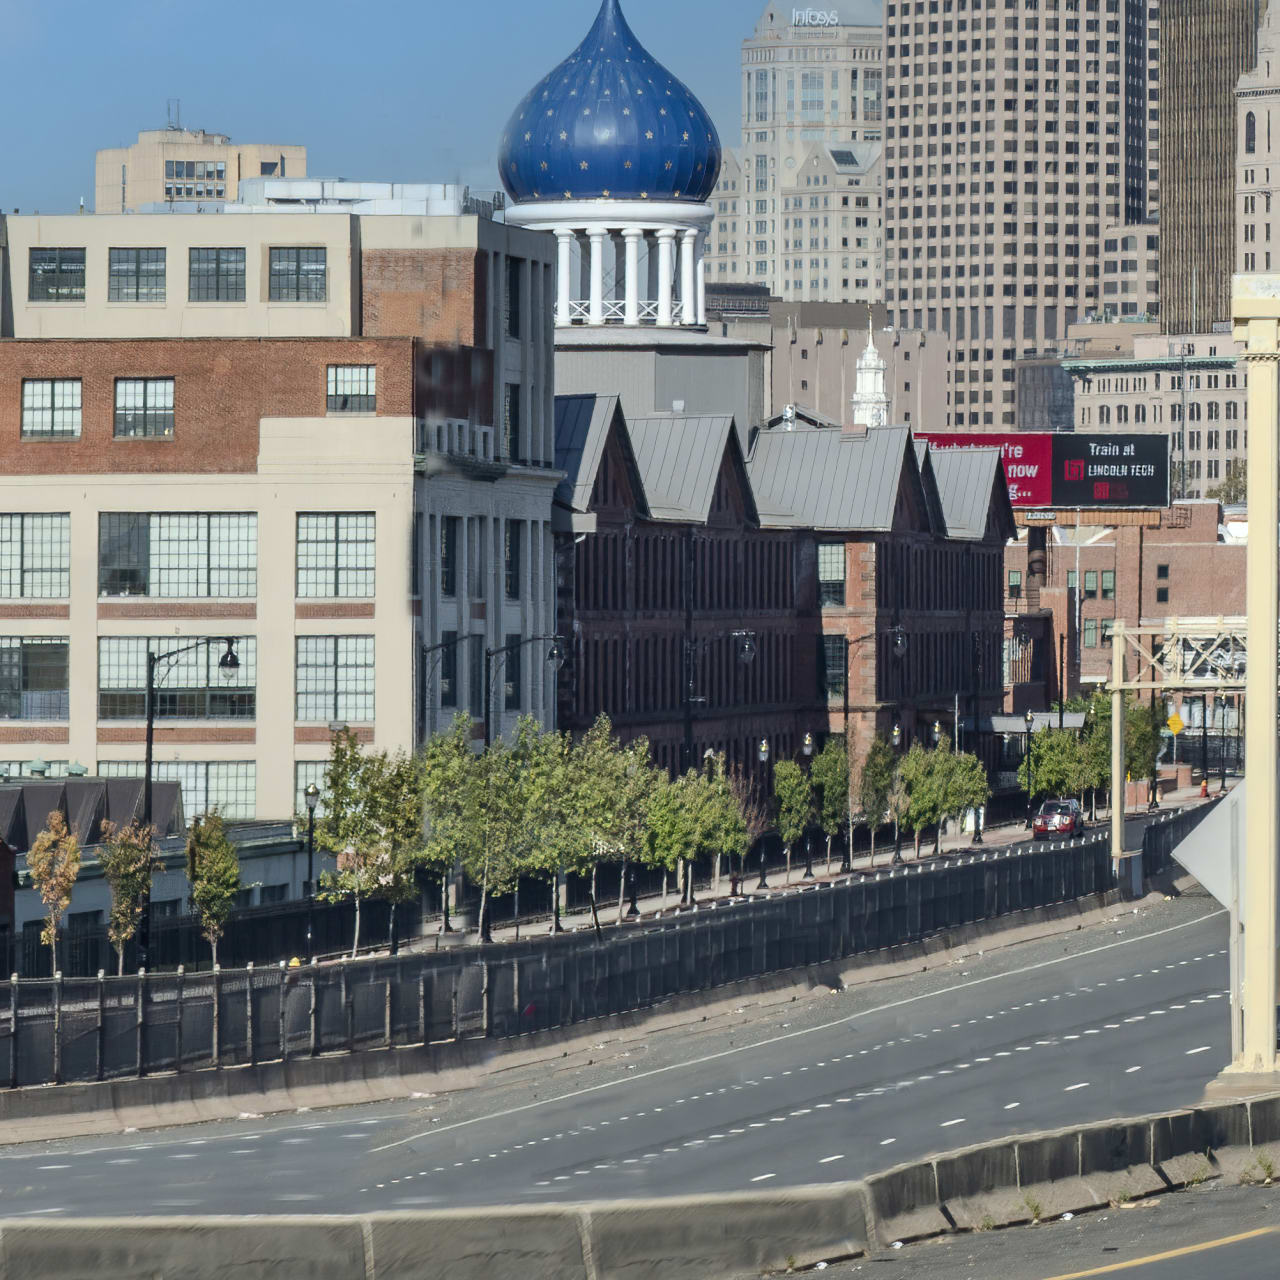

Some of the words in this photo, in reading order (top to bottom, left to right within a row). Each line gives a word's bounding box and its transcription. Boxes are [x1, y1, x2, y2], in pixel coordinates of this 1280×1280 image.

[792, 7, 838, 26] Infosys
[1089, 443, 1119, 456] Train
[1123, 444, 1135, 456] at
[1088, 465, 1128, 476] LINCOLN
[1130, 465, 1154, 476] TECH
